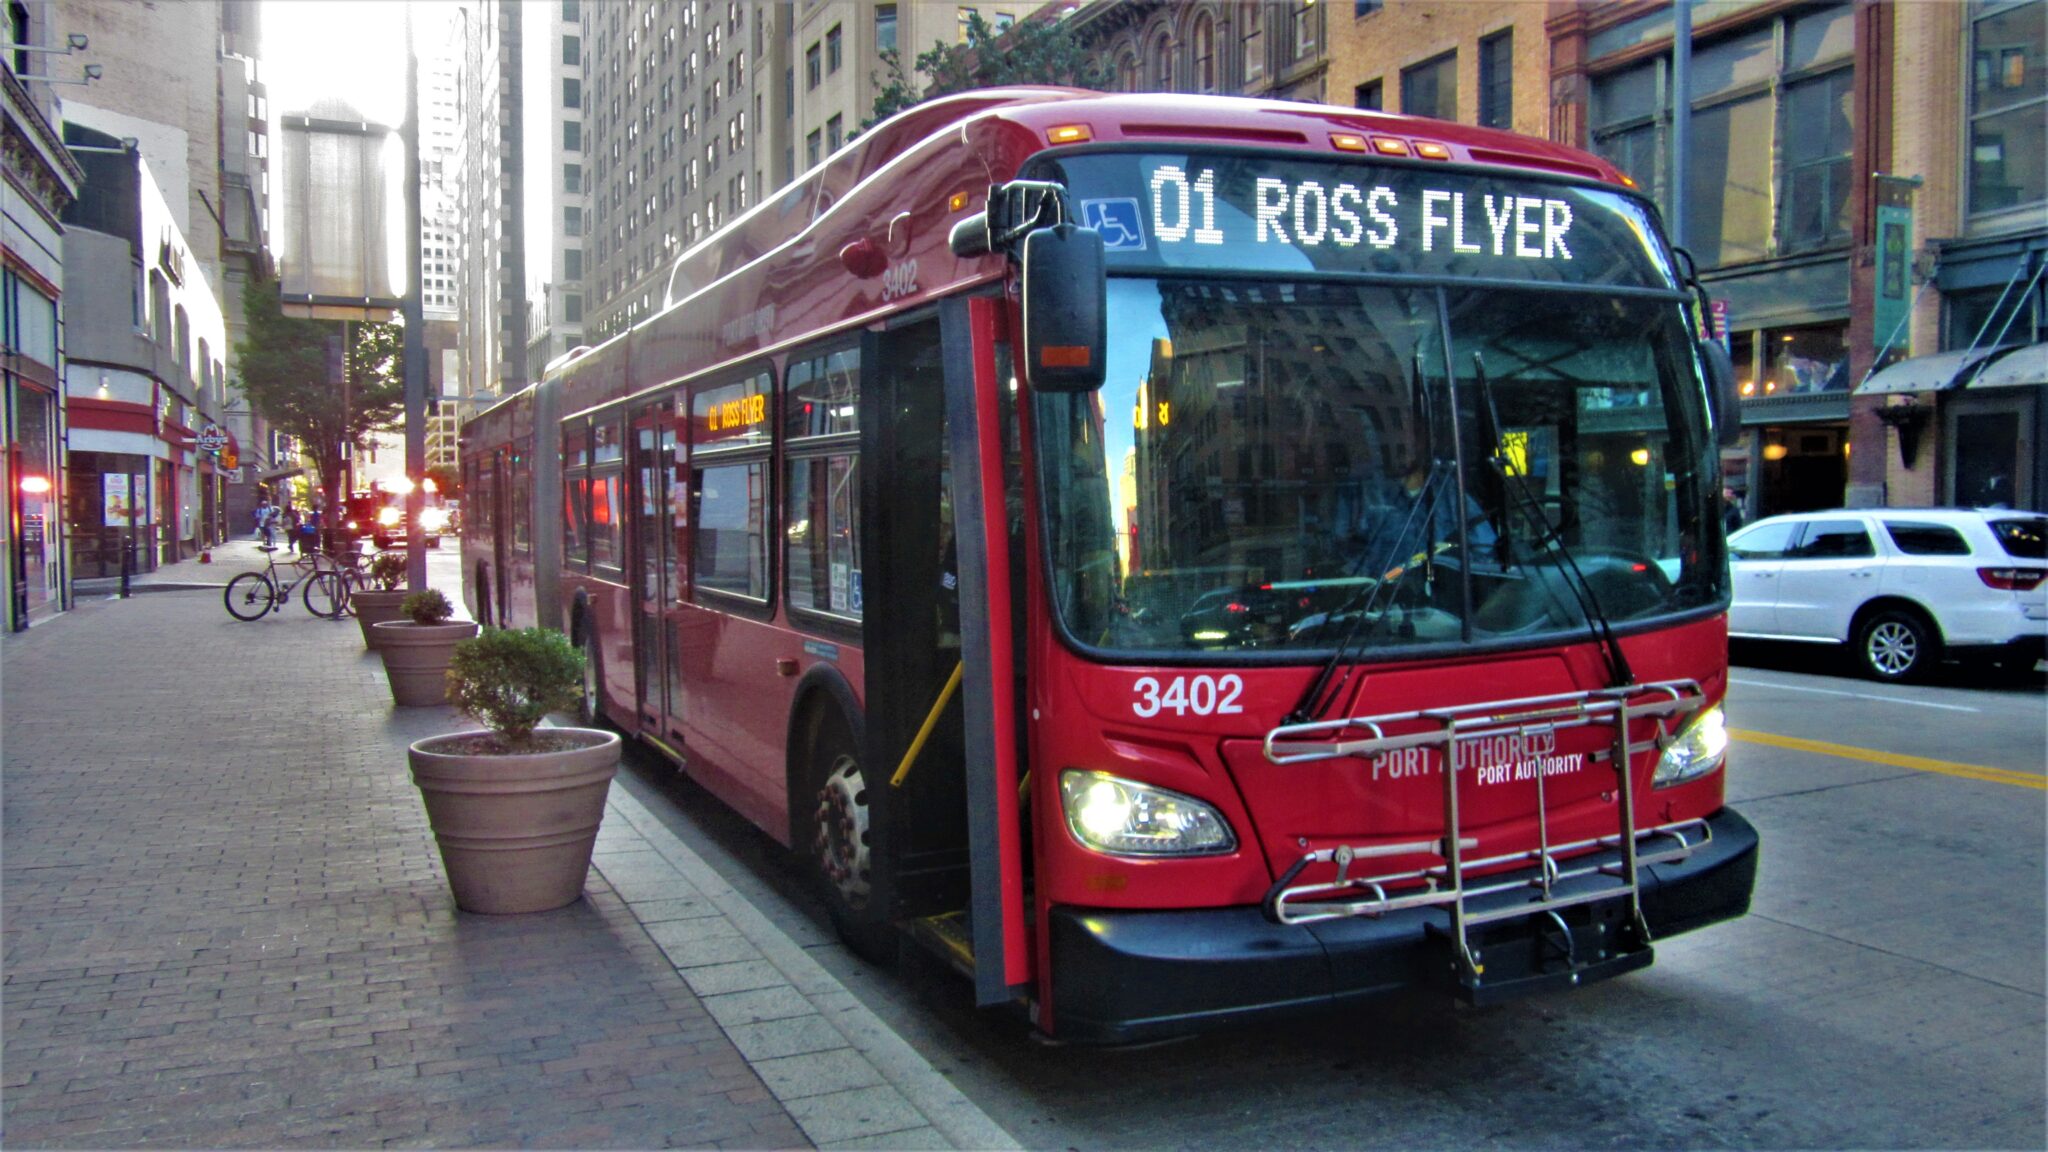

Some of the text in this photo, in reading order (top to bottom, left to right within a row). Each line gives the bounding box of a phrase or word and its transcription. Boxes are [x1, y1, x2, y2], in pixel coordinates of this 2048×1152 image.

[1151, 165, 1573, 260] 01 ROSS FLYER
[882, 258, 918, 302] 3402
[722, 399, 740, 429] ROSS
[741, 393, 765, 426] FLYER
[1132, 673, 1244, 718] 3402
[1372, 734, 1553, 780] PORT UTHORITY
[1477, 753, 1583, 786] PORT AUTHORITY
